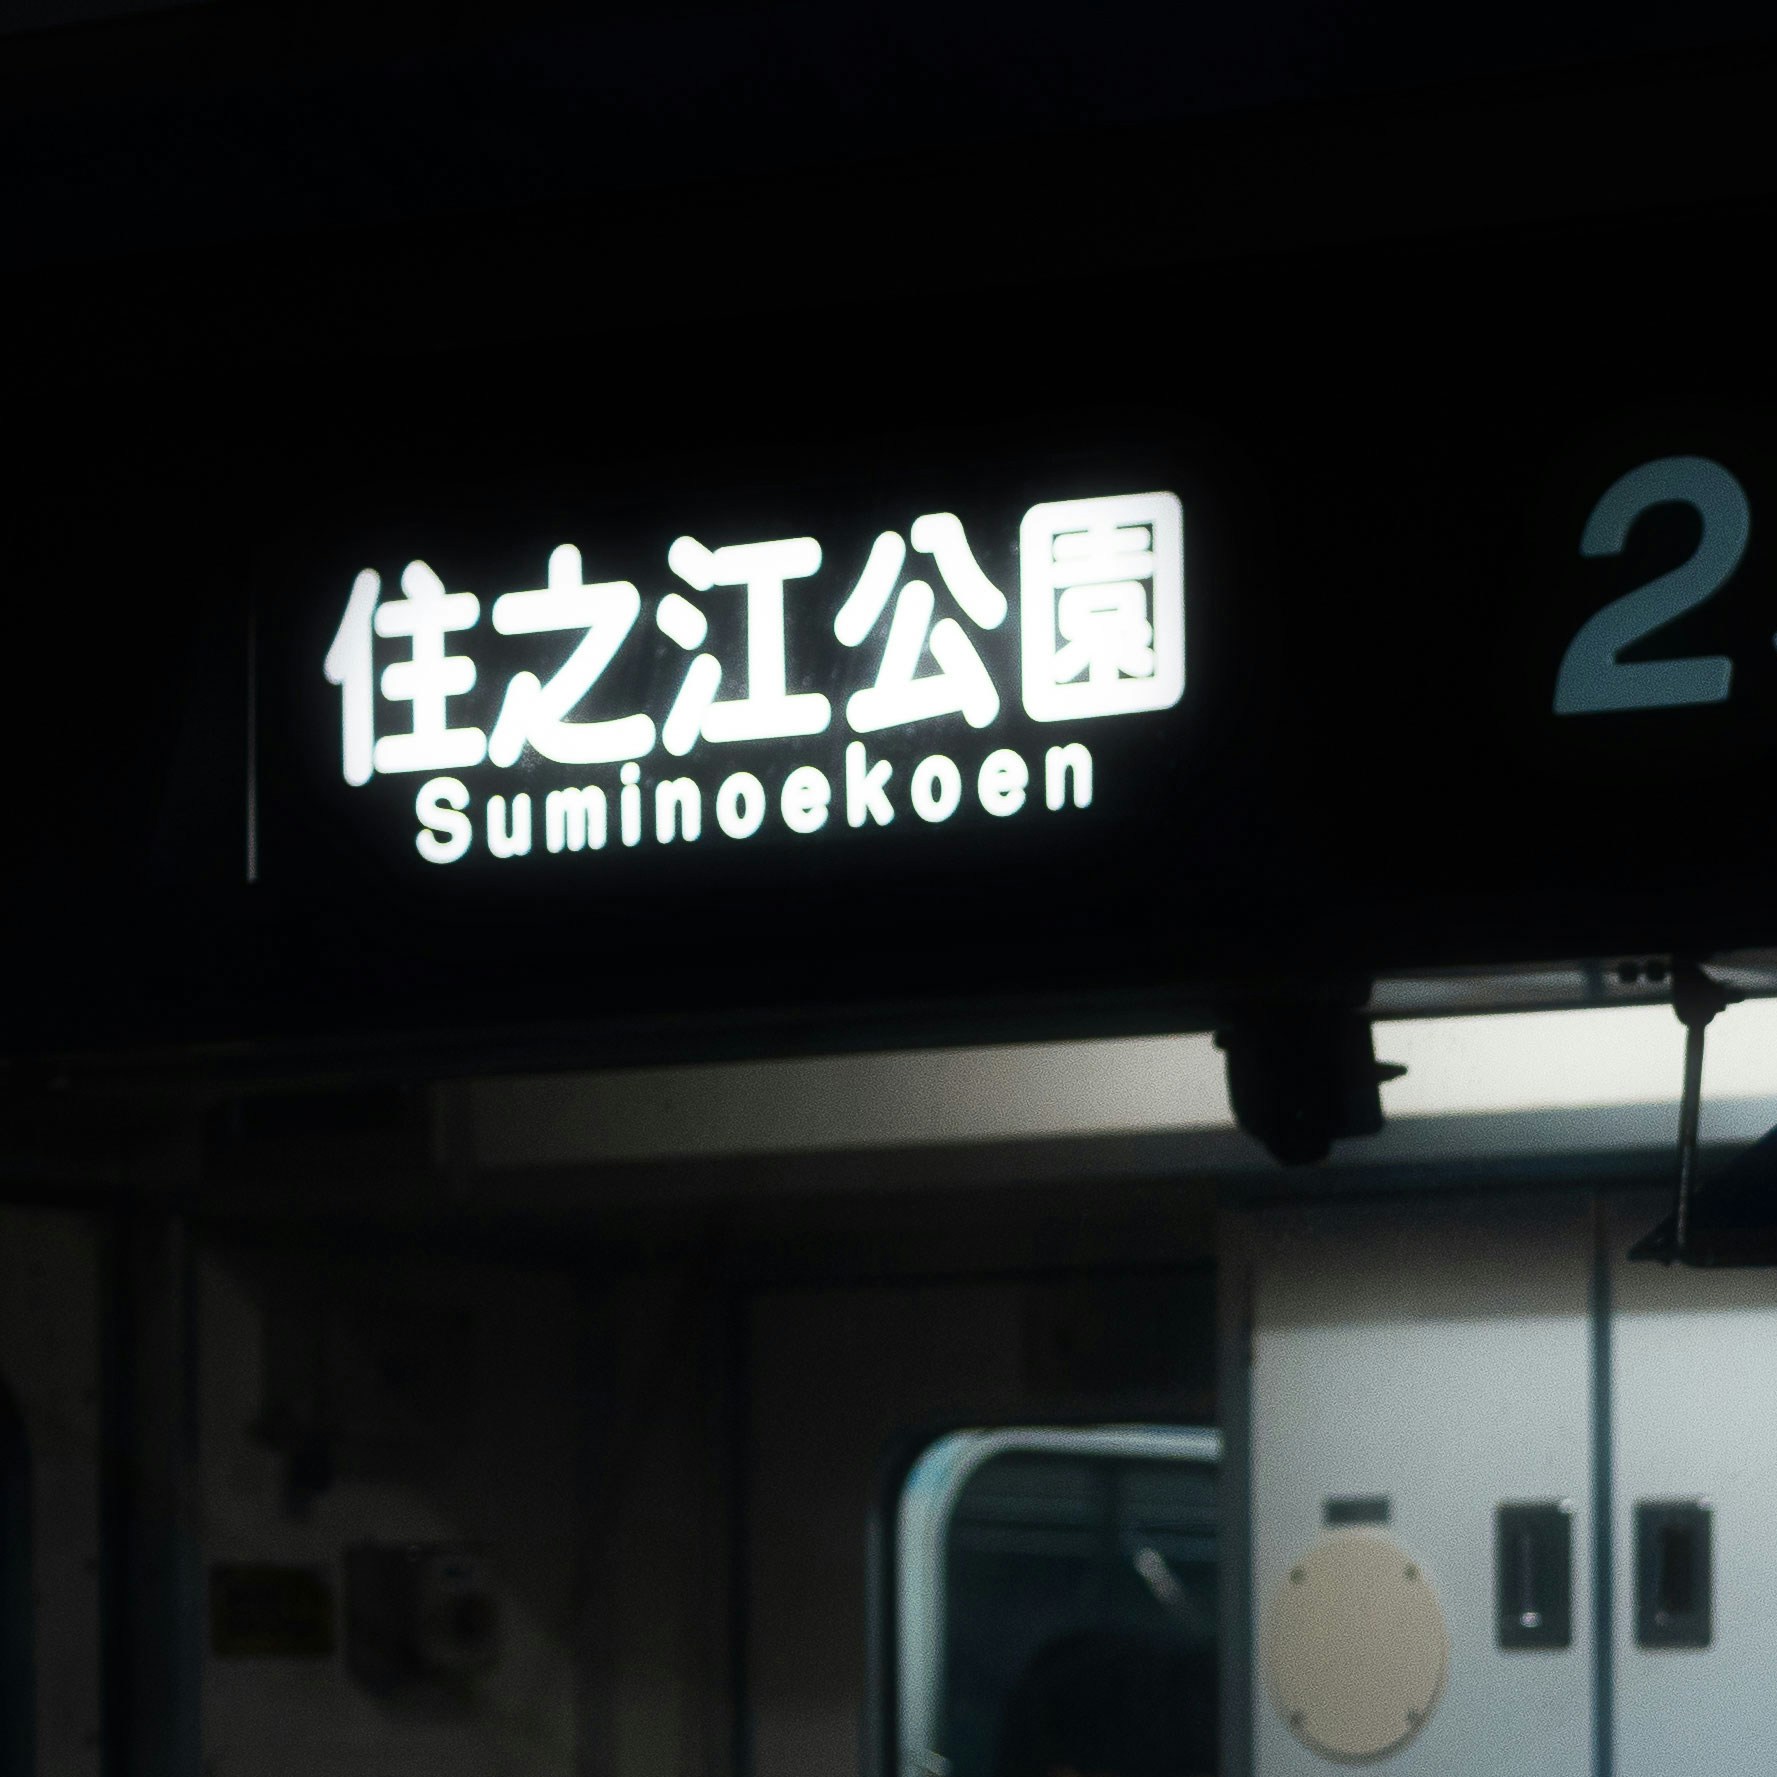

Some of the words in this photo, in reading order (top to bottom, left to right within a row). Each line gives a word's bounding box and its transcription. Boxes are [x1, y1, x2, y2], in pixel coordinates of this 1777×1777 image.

[324, 490, 1184, 786] 住之江公園
[414, 740, 1094, 864] Suminoekoen
